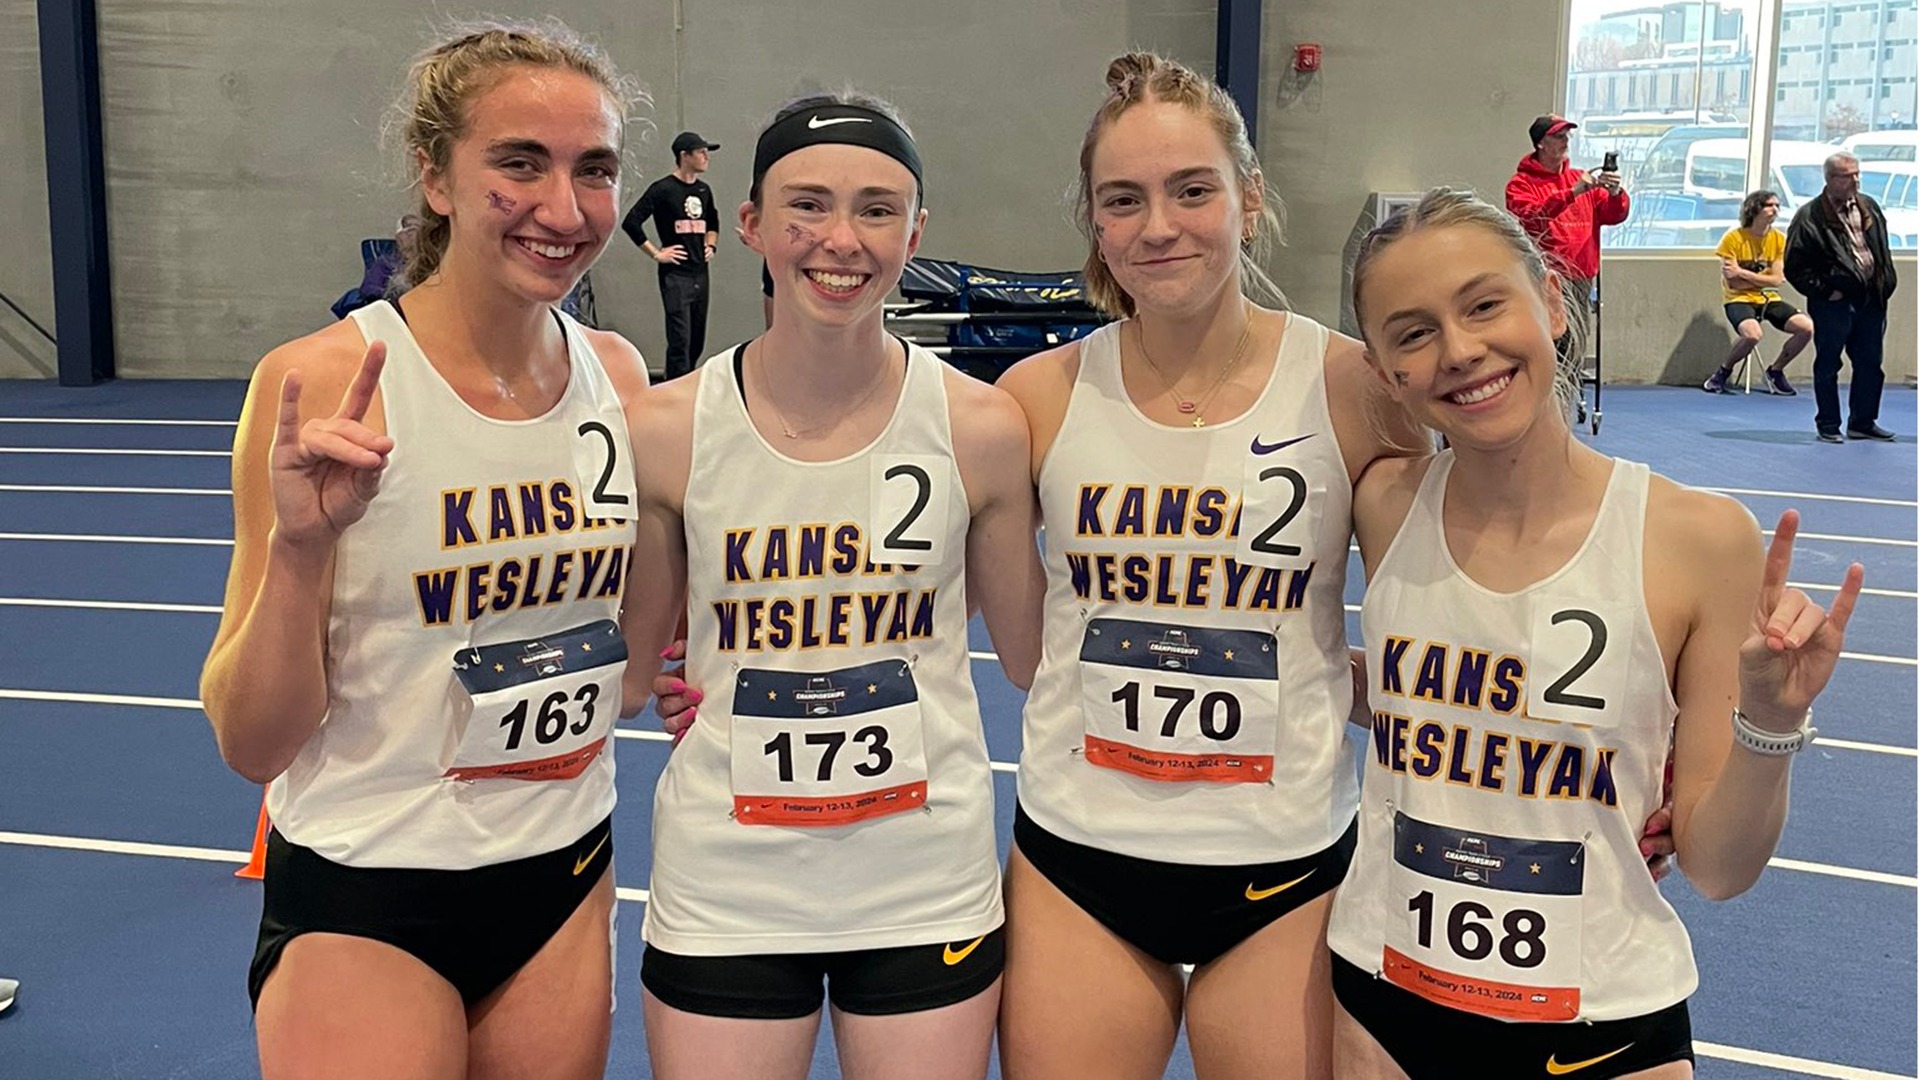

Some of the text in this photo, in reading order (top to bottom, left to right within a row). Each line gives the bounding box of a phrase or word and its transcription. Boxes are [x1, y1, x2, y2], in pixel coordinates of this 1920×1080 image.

[578, 421, 629, 504] 2
[440, 478, 626, 550] KANS
[884, 464, 932, 550] 2
[1075, 483, 1243, 539] KANS
[1251, 467, 1308, 556] 2
[412, 545, 635, 627] WESLEYA
[723, 520, 920, 585] KANS
[1065, 552, 1317, 611] WESLEYAN
[711, 587, 938, 652] WESLEYAN
[1381, 634, 1562, 724] KANS
[1543, 609, 1608, 709] 2
[499, 682, 600, 751] 163
[1112, 681, 1242, 742] 170
[764, 725, 894, 782] 173
[1128, 752, 1164, 767] February
[1373, 710, 1619, 810] WESLEYAN
[783, 803, 823, 813] February
[1445, 851, 1501, 868] CHAMPIONSHIPS
[1408, 890, 1547, 968] 168
[1418, 970, 1458, 992] February
[1496, 989, 1523, 1001] 2024
